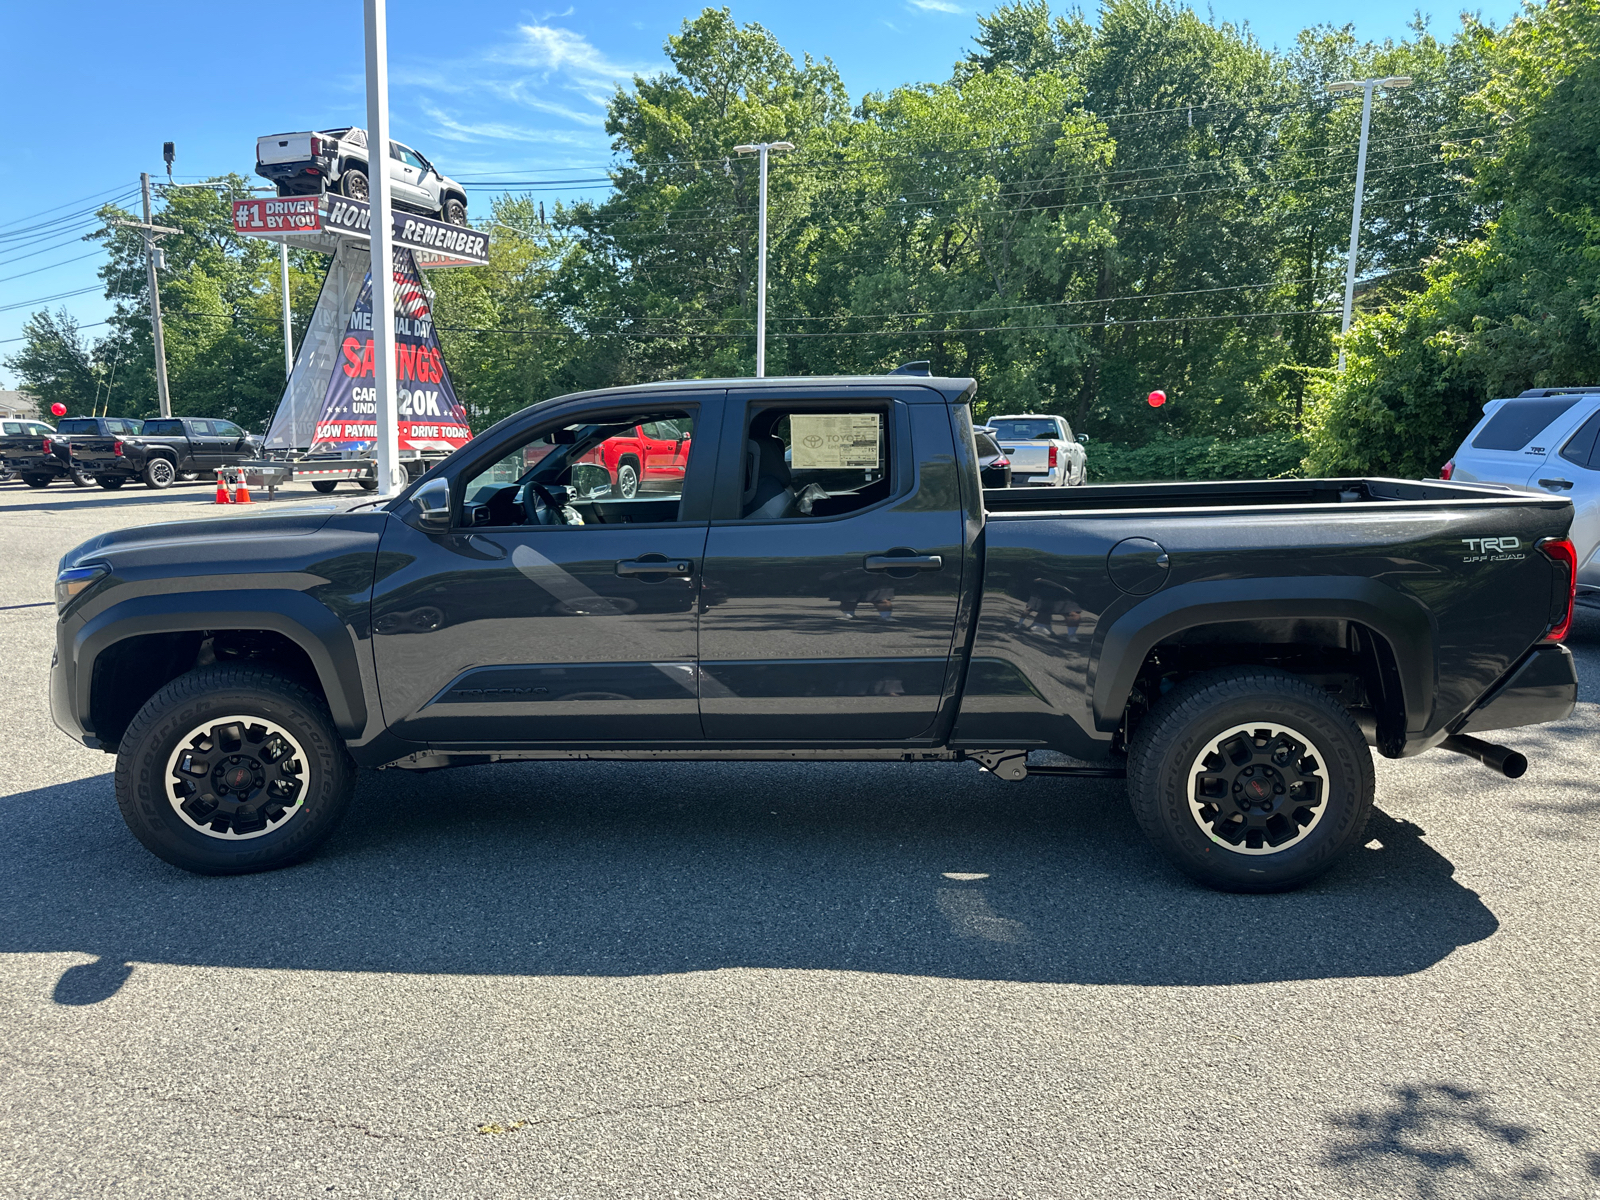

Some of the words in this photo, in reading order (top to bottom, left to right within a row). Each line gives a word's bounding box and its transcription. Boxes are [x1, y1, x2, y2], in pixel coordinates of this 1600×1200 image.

[266, 200, 315, 214] DRIVEN
[236, 204, 264, 228] #1
[266, 216, 284, 228] BY
[286, 214, 316, 227] YOU
[330, 202, 396, 236] HON.
[402, 219, 486, 257] REMEMBER.
[350, 312, 412, 336] MEIAL
[414, 320, 432, 338] DAY
[342, 337, 443, 384] SAINGS
[352, 386, 376, 402] CAR
[352, 402, 376, 414] UND
[318, 424, 342, 438] LOW
[411, 426, 438, 438] DRIVE
[440, 426, 468, 438] TODAY
[826, 434, 867, 442] TOYOTA
[1462, 536, 1520, 554] TRD
[1490, 554, 1526, 562] ROAD
[452, 687, 549, 696] TACOMA
